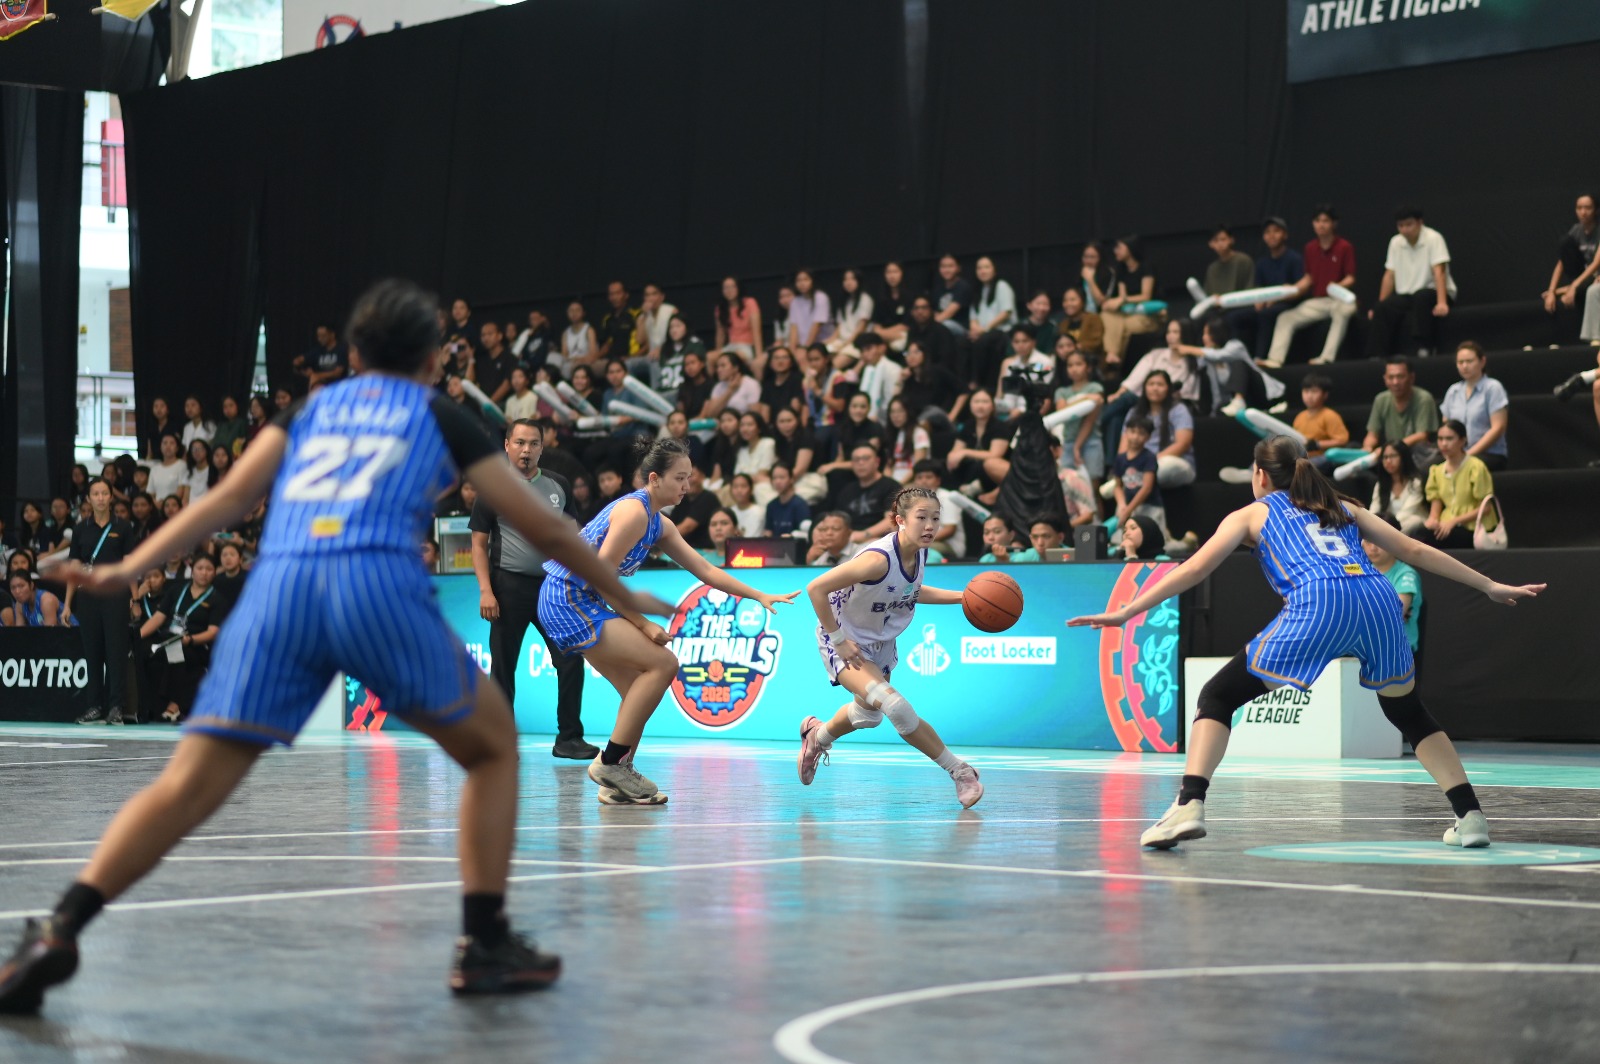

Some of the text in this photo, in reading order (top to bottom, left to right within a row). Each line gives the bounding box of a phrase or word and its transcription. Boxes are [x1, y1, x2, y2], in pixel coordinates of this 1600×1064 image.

[283, 434, 411, 501] 27
[1305, 522, 1350, 557] 6
[701, 614, 735, 638] THE
[965, 641, 1052, 659] Foot Locker
[0, 658, 106, 688] OLYTRO
[701, 686, 731, 703] 2026
[1252, 689, 1312, 705] AMPUS
[1246, 707, 1303, 724] LEAGUE
